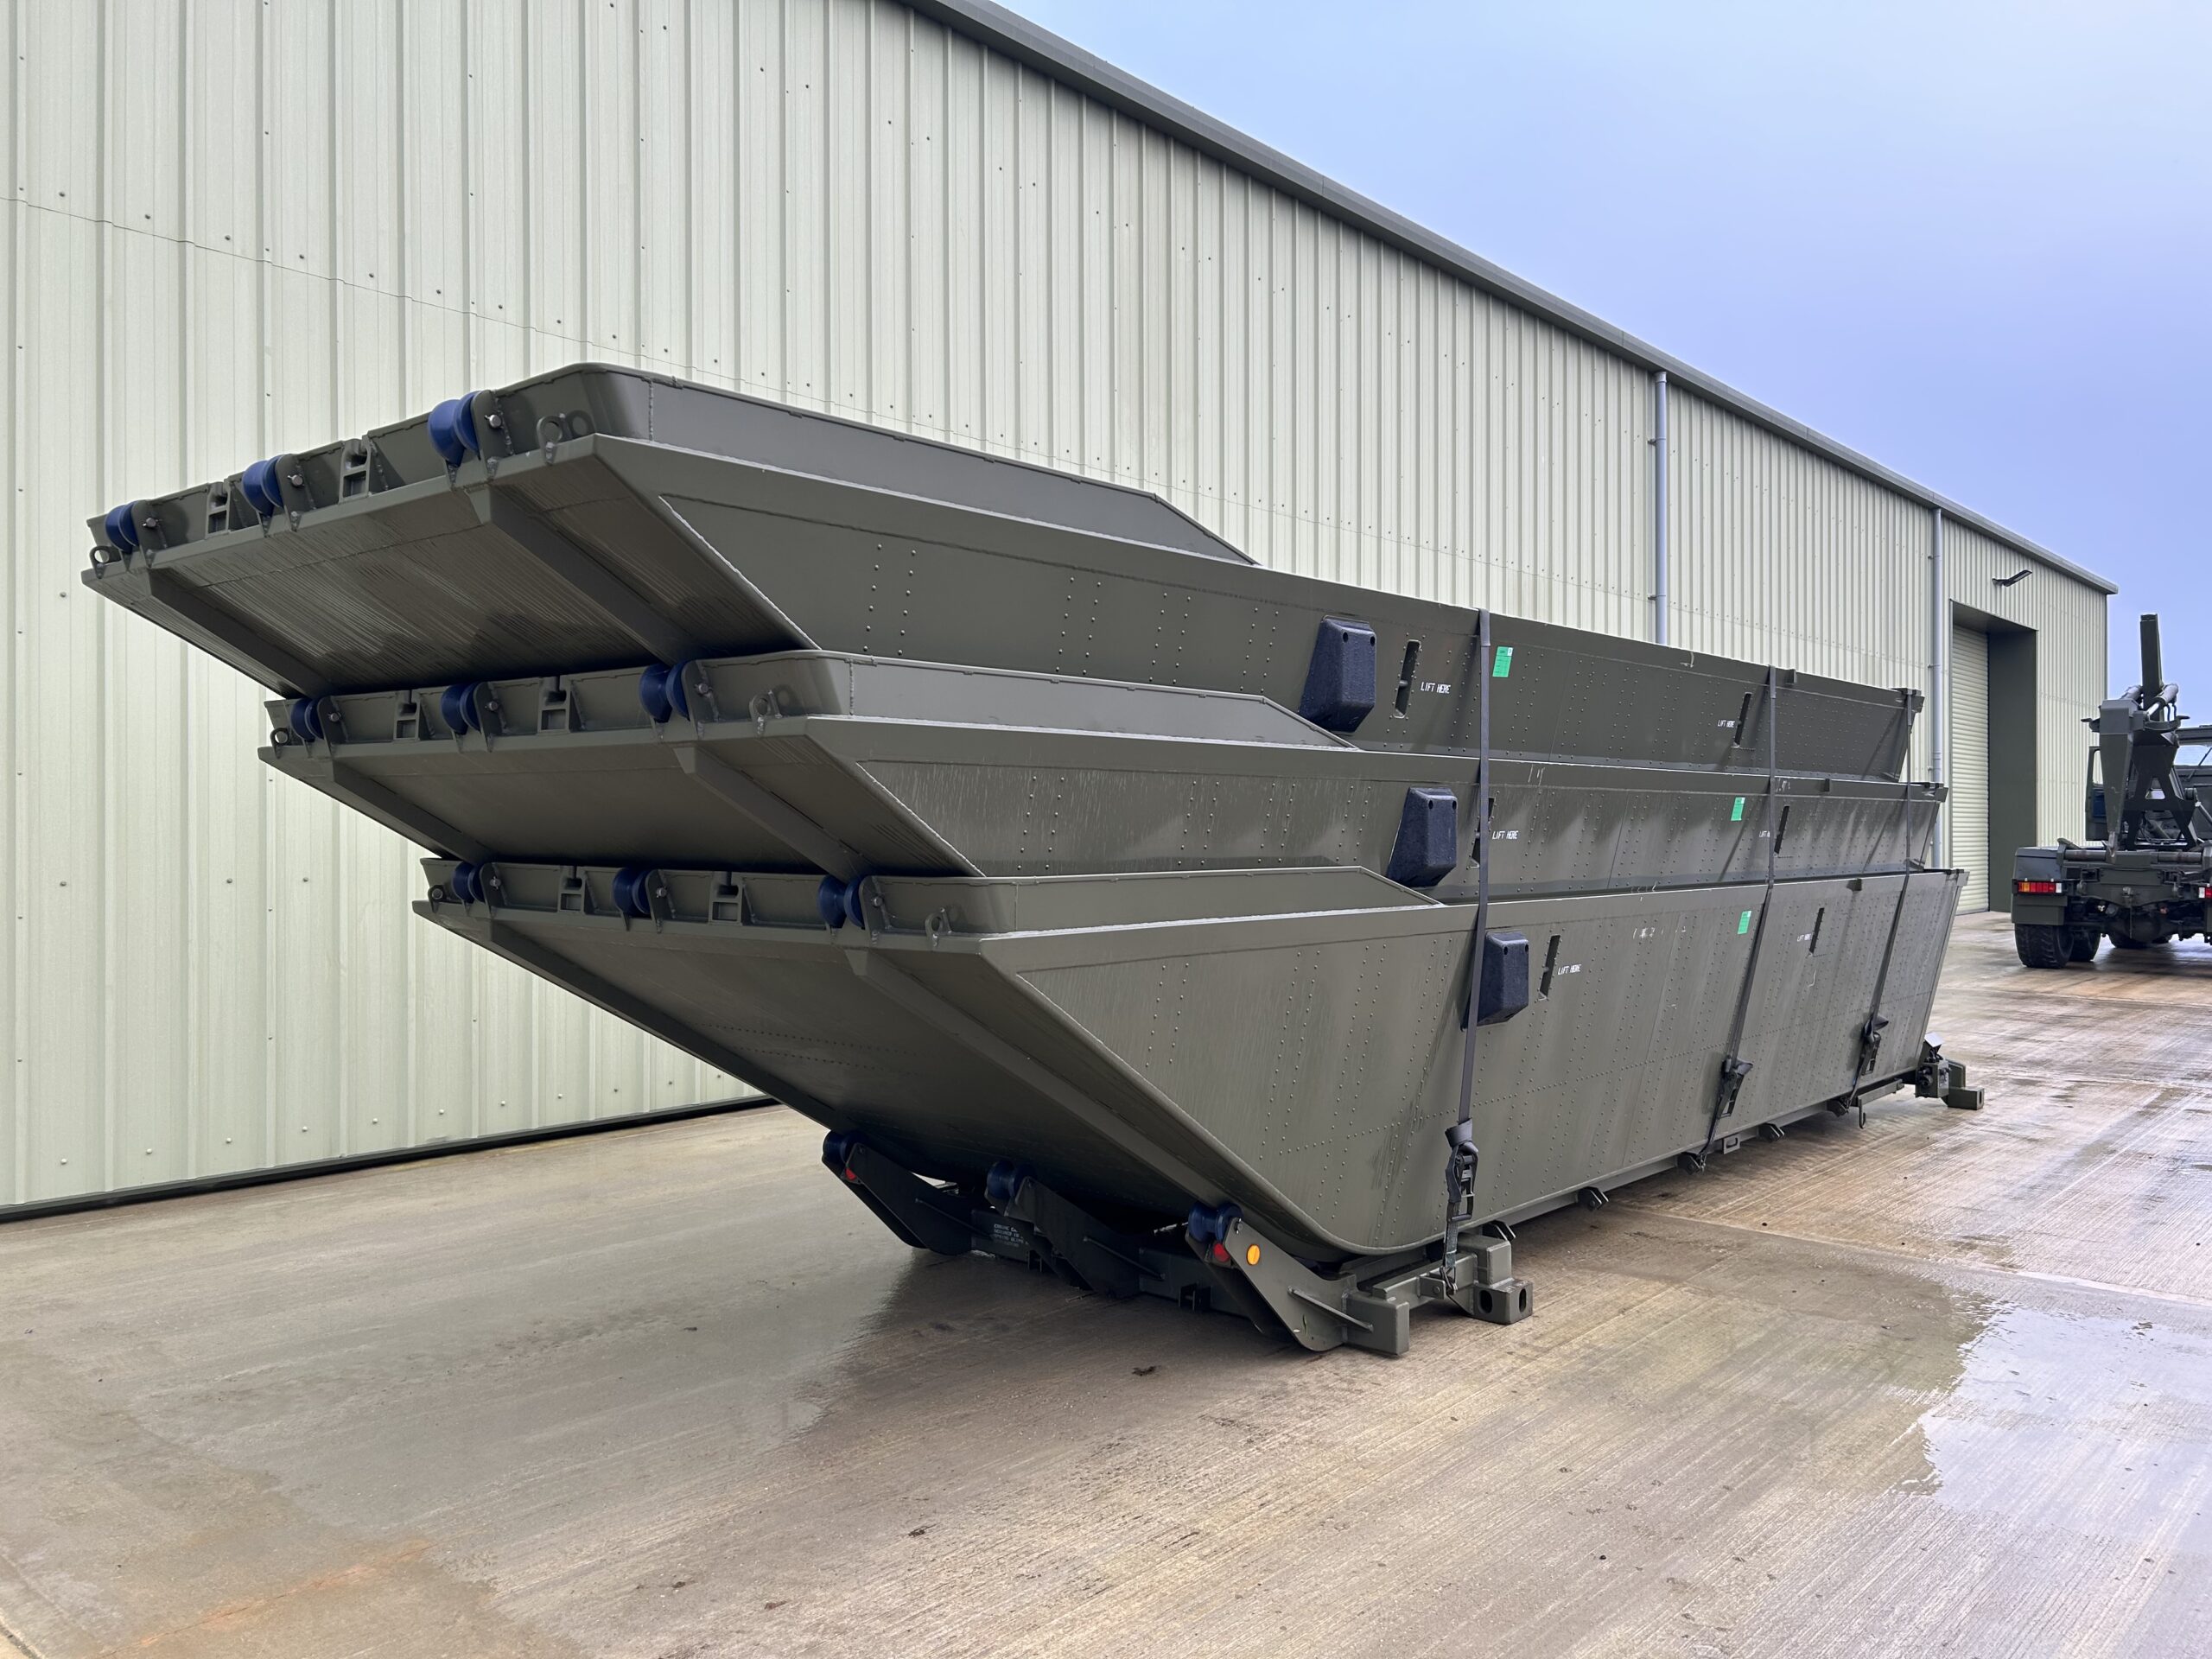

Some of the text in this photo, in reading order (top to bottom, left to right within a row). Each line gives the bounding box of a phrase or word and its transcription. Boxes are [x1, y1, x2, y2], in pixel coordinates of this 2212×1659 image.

[1421, 682, 1452, 694] LIFT HERE
[1492, 830, 1519, 840] LIFT HERE
[1558, 963, 1582, 976] LIFT HERE
